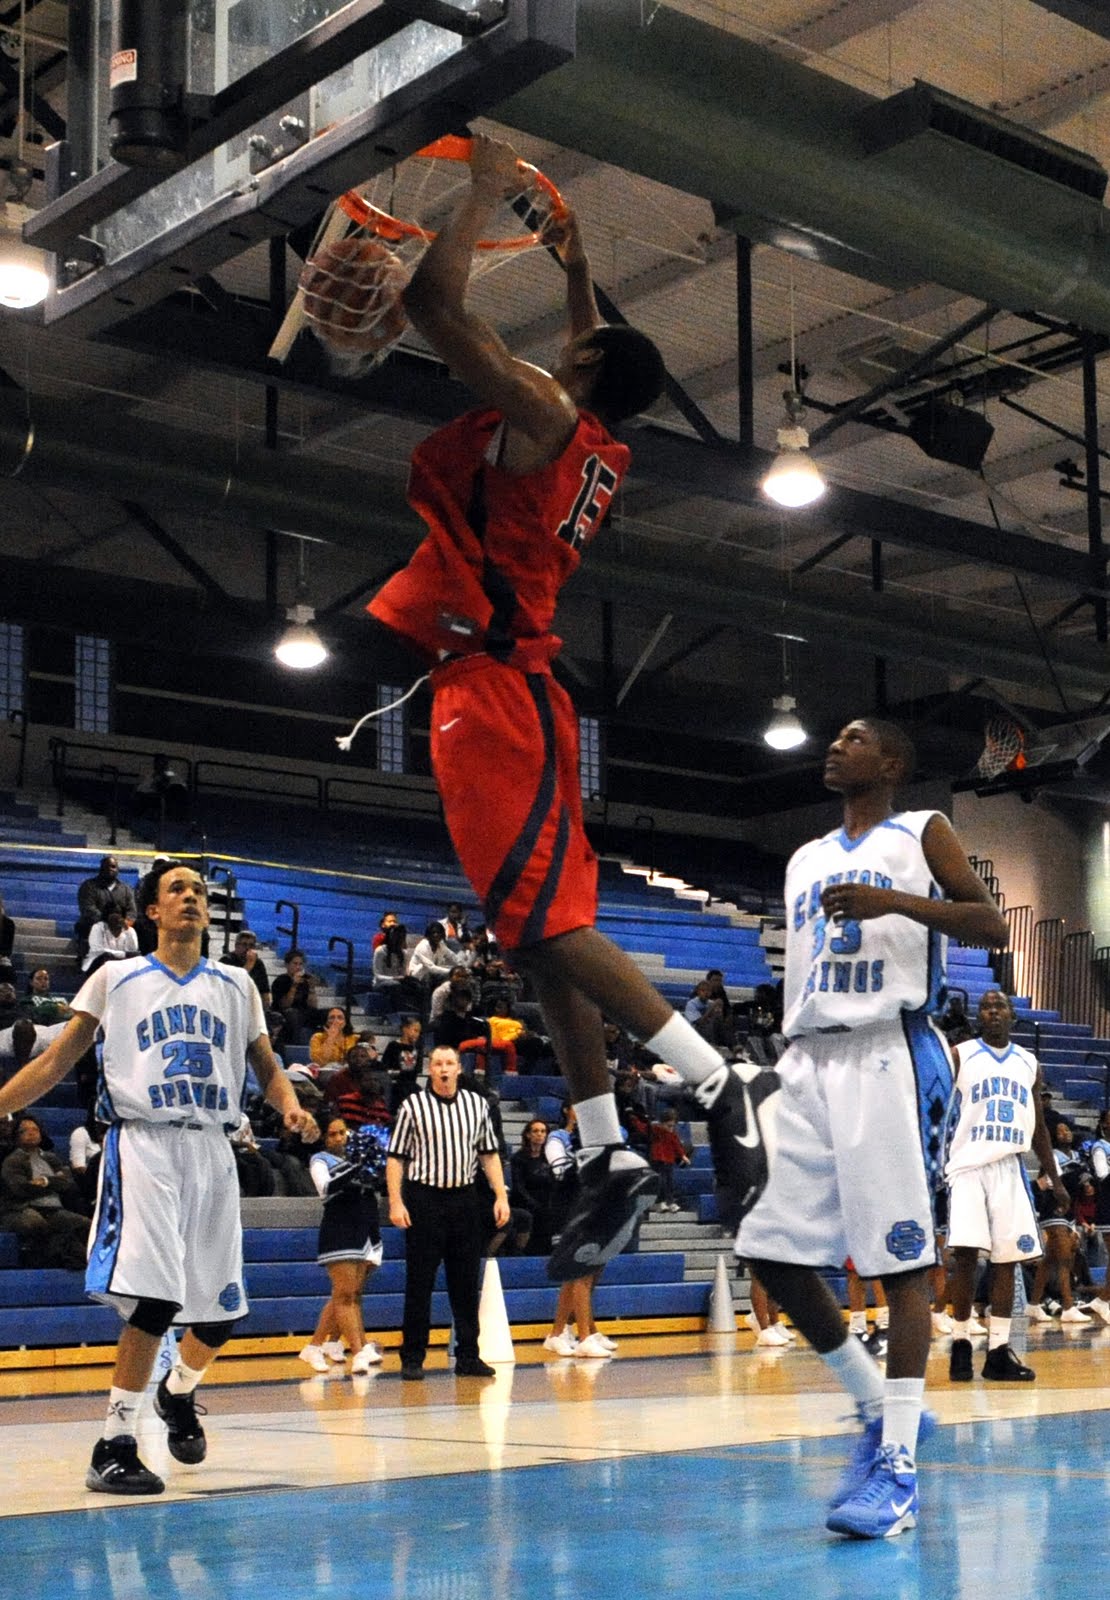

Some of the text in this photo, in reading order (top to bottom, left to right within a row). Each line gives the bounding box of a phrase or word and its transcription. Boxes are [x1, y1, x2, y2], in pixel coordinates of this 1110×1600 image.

[803, 959, 885, 1003] INGS
[136, 1004, 227, 1053] CANYON
[161, 1040, 213, 1078] 25
[147, 1079, 229, 1111] SPRNGS
[970, 1076, 1029, 1108] CANYON
[985, 1099, 1015, 1123] 15
[970, 1124, 1024, 1145] SPRINGS
